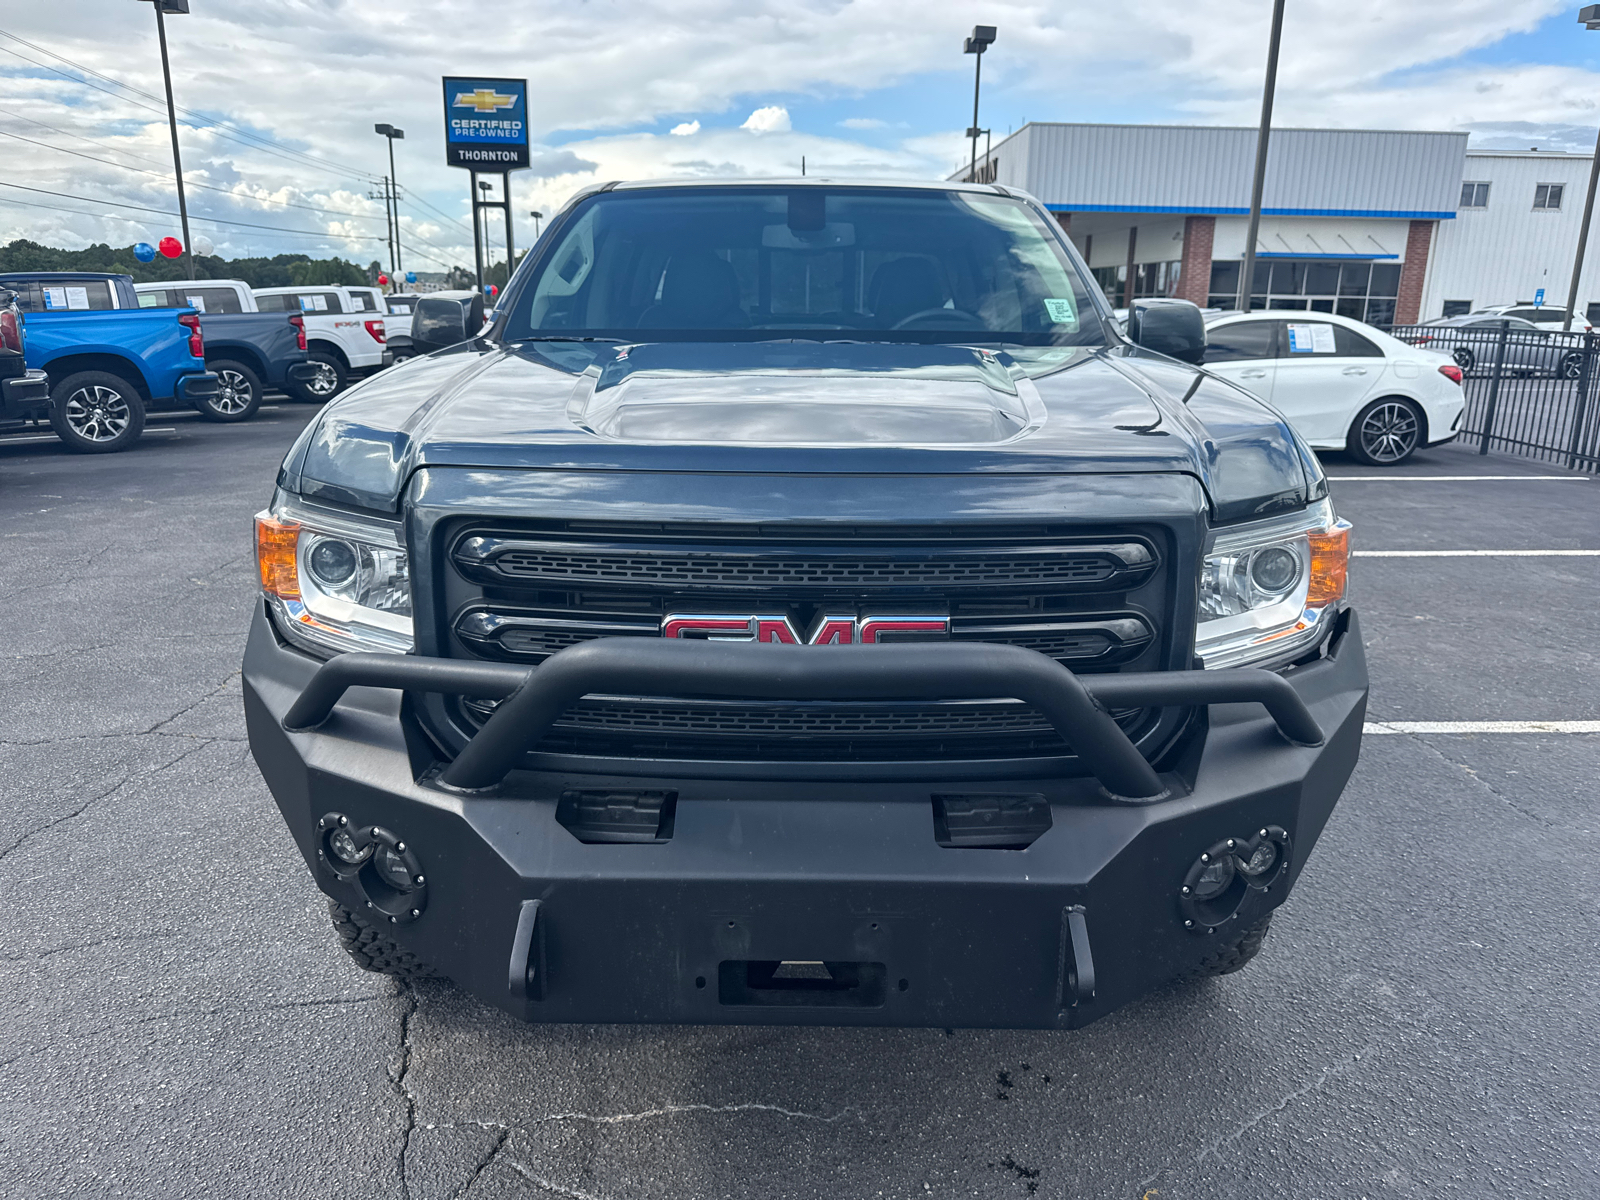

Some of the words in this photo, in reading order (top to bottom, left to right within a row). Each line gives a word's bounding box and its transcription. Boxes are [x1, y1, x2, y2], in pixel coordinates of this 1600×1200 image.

[451, 119, 522, 129] CERTIFIED
[455, 128, 519, 138] PRE-OWNED
[458, 150, 518, 161] THORNTON
